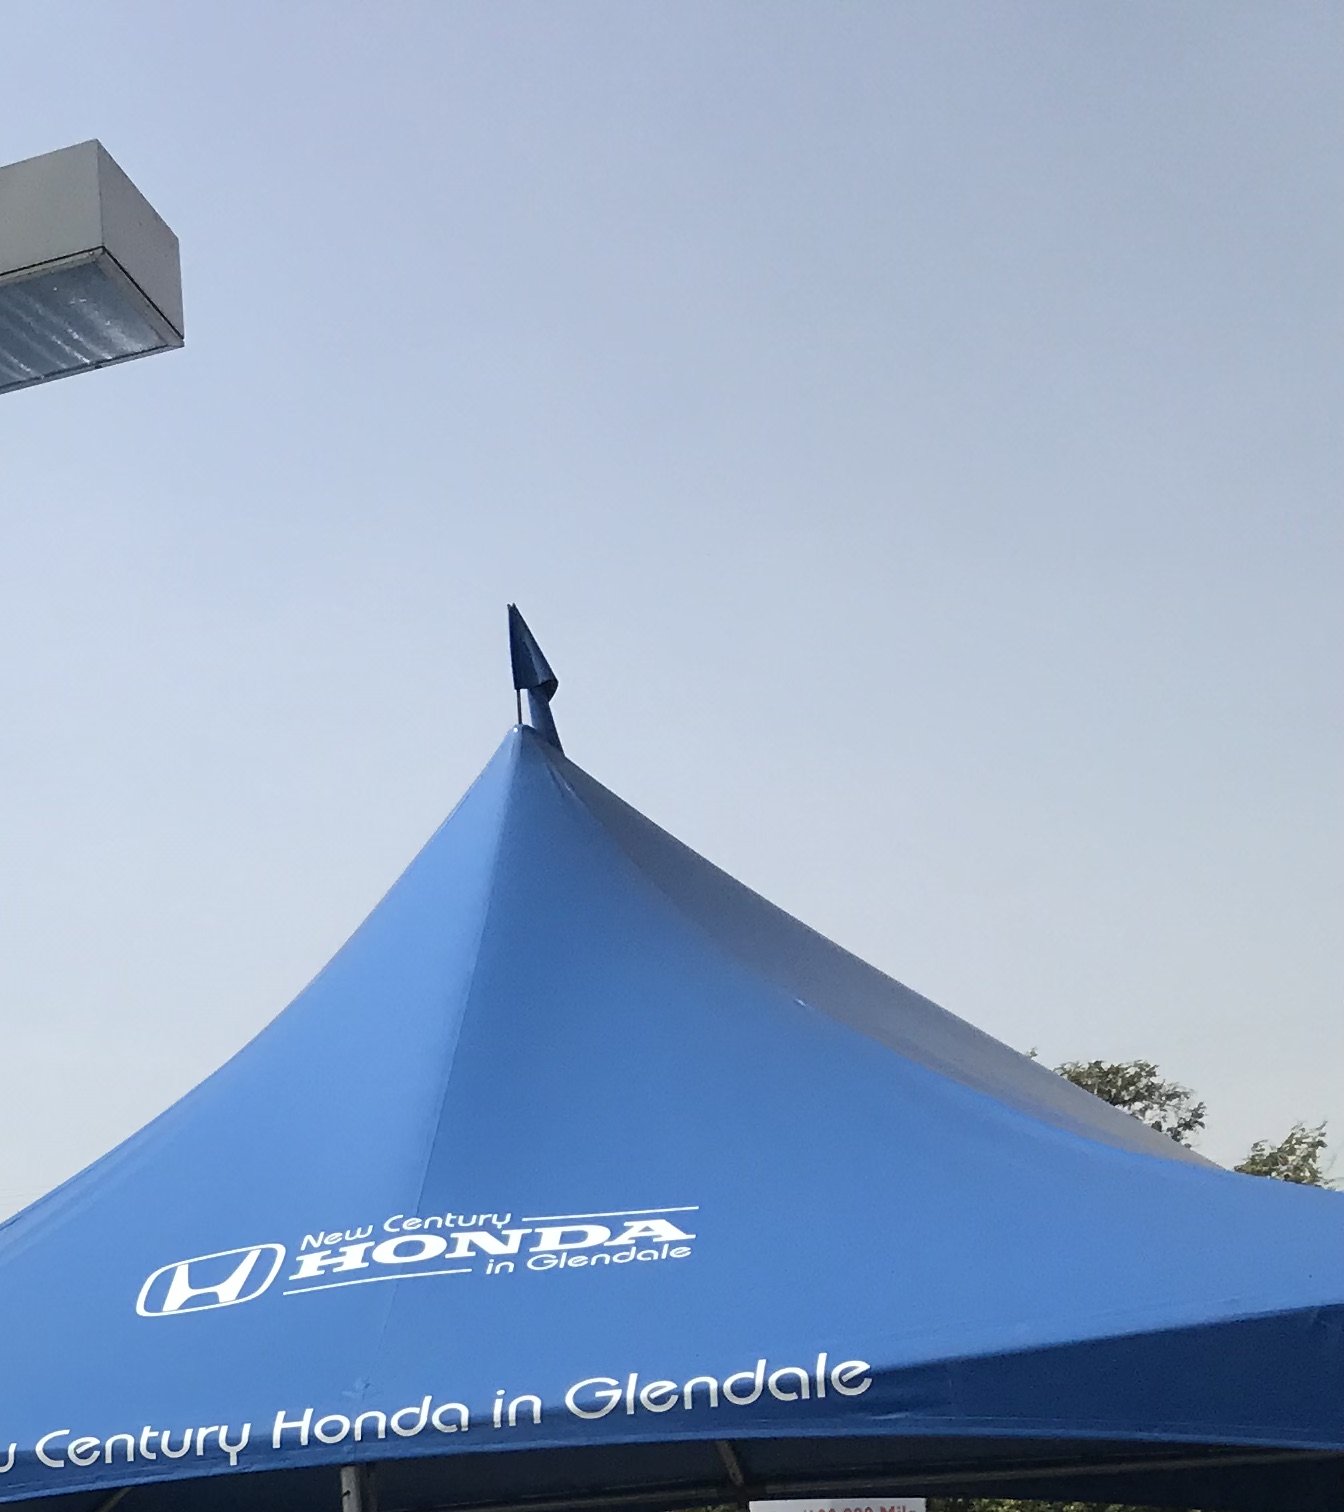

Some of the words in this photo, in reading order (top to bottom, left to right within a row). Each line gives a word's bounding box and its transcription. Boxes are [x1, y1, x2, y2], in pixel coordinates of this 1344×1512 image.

[289, 1218, 697, 1281] HONDA
[300, 1224, 374, 1252] New
[383, 1212, 512, 1236] Century
[485, 1257, 514, 1276] in
[527, 1245, 692, 1272] Glendale
[35, 1422, 251, 1466] Century
[272, 1395, 469, 1449] Honda
[493, 1389, 541, 1429] in
[565, 1352, 872, 1419] Glendale
